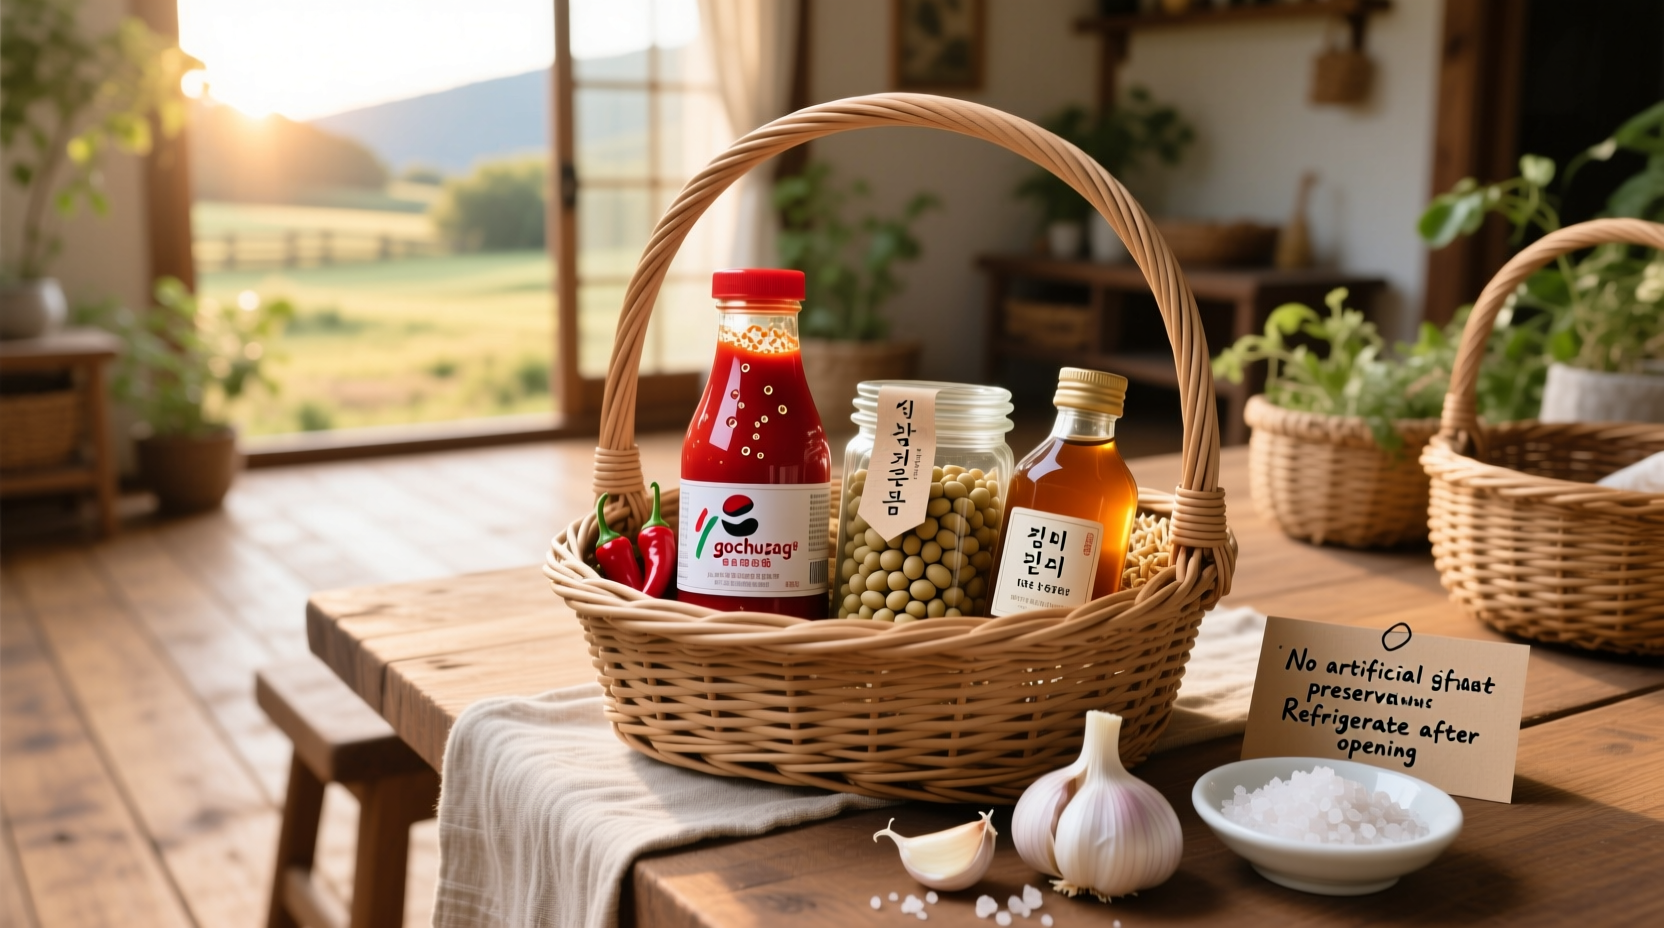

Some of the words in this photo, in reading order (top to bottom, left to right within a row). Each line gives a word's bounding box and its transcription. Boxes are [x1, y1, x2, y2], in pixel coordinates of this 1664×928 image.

[1285, 647, 1317, 672] No
[1326, 658, 1424, 684] artificial
[1282, 697, 1410, 736] Refrigerate
[1419, 720, 1480, 745] after
[1337, 738, 1417, 768] opening
